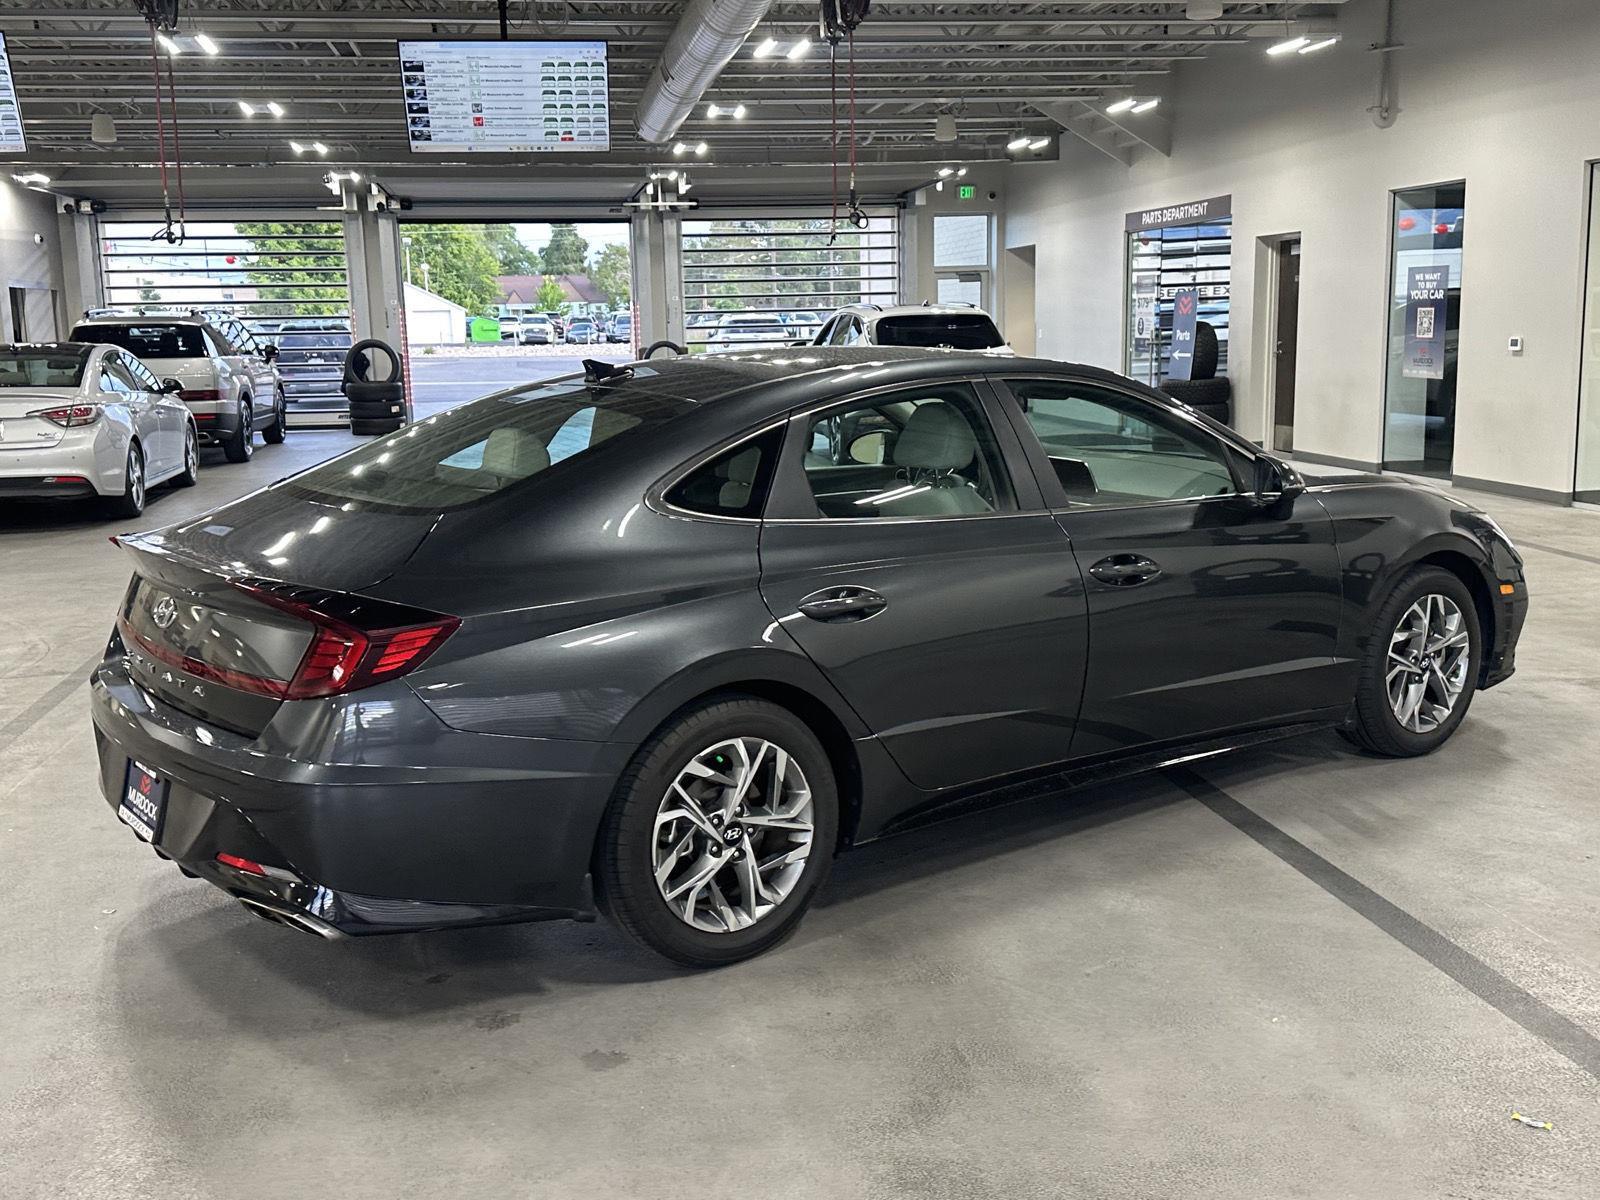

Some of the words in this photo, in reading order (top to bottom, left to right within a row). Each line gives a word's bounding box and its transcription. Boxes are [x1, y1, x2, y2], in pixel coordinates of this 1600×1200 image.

[1142, 212, 1162, 225] PARTS
[1162, 202, 1208, 222] DEPARTMENT
[1415, 273, 1424, 281] WE
[1424, 272, 1441, 280] WANT
[1418, 281, 1425, 289] TO
[1425, 281, 1437, 289] BUY
[1410, 289, 1428, 300] YOUR
[1429, 289, 1444, 299] CAR
[1176, 329, 1190, 341] Parts
[127, 785, 158, 821] MURDOCK
